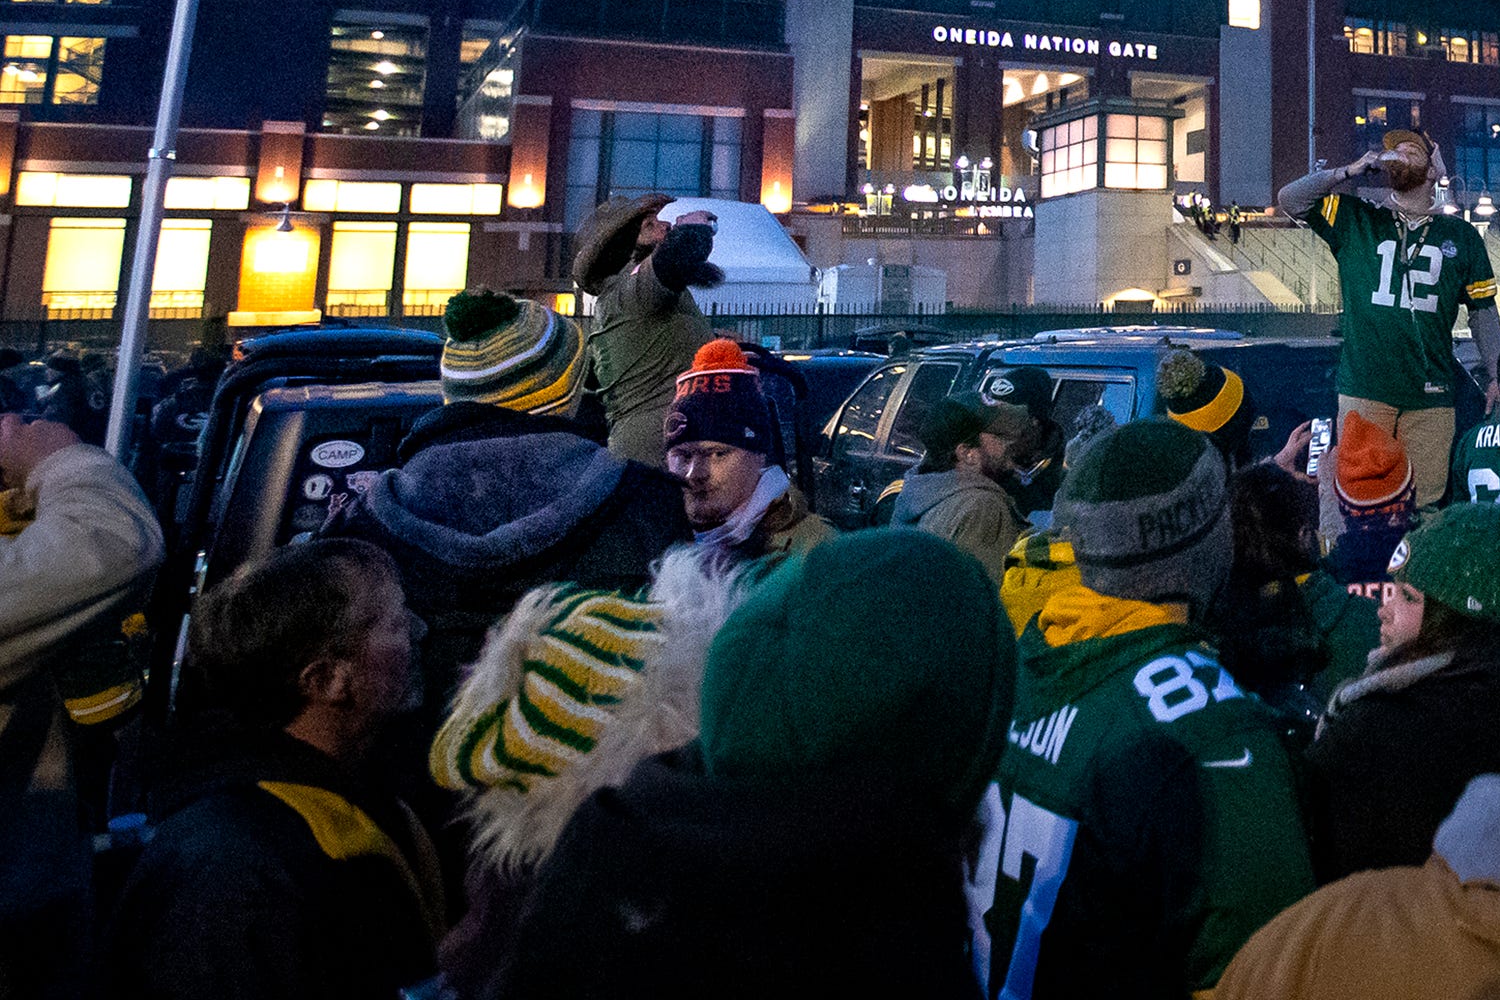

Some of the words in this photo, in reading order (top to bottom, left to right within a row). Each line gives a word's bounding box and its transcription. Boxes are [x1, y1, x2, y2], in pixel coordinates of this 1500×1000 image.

[932, 25, 1014, 48] ONEIDA
[1024, 34, 1100, 55] NATION
[1108, 41, 1158, 60] GATE
[943, 185, 1026, 203] ONEIDA
[1371, 239, 1443, 313] 12
[318, 449, 358, 461] CAMP
